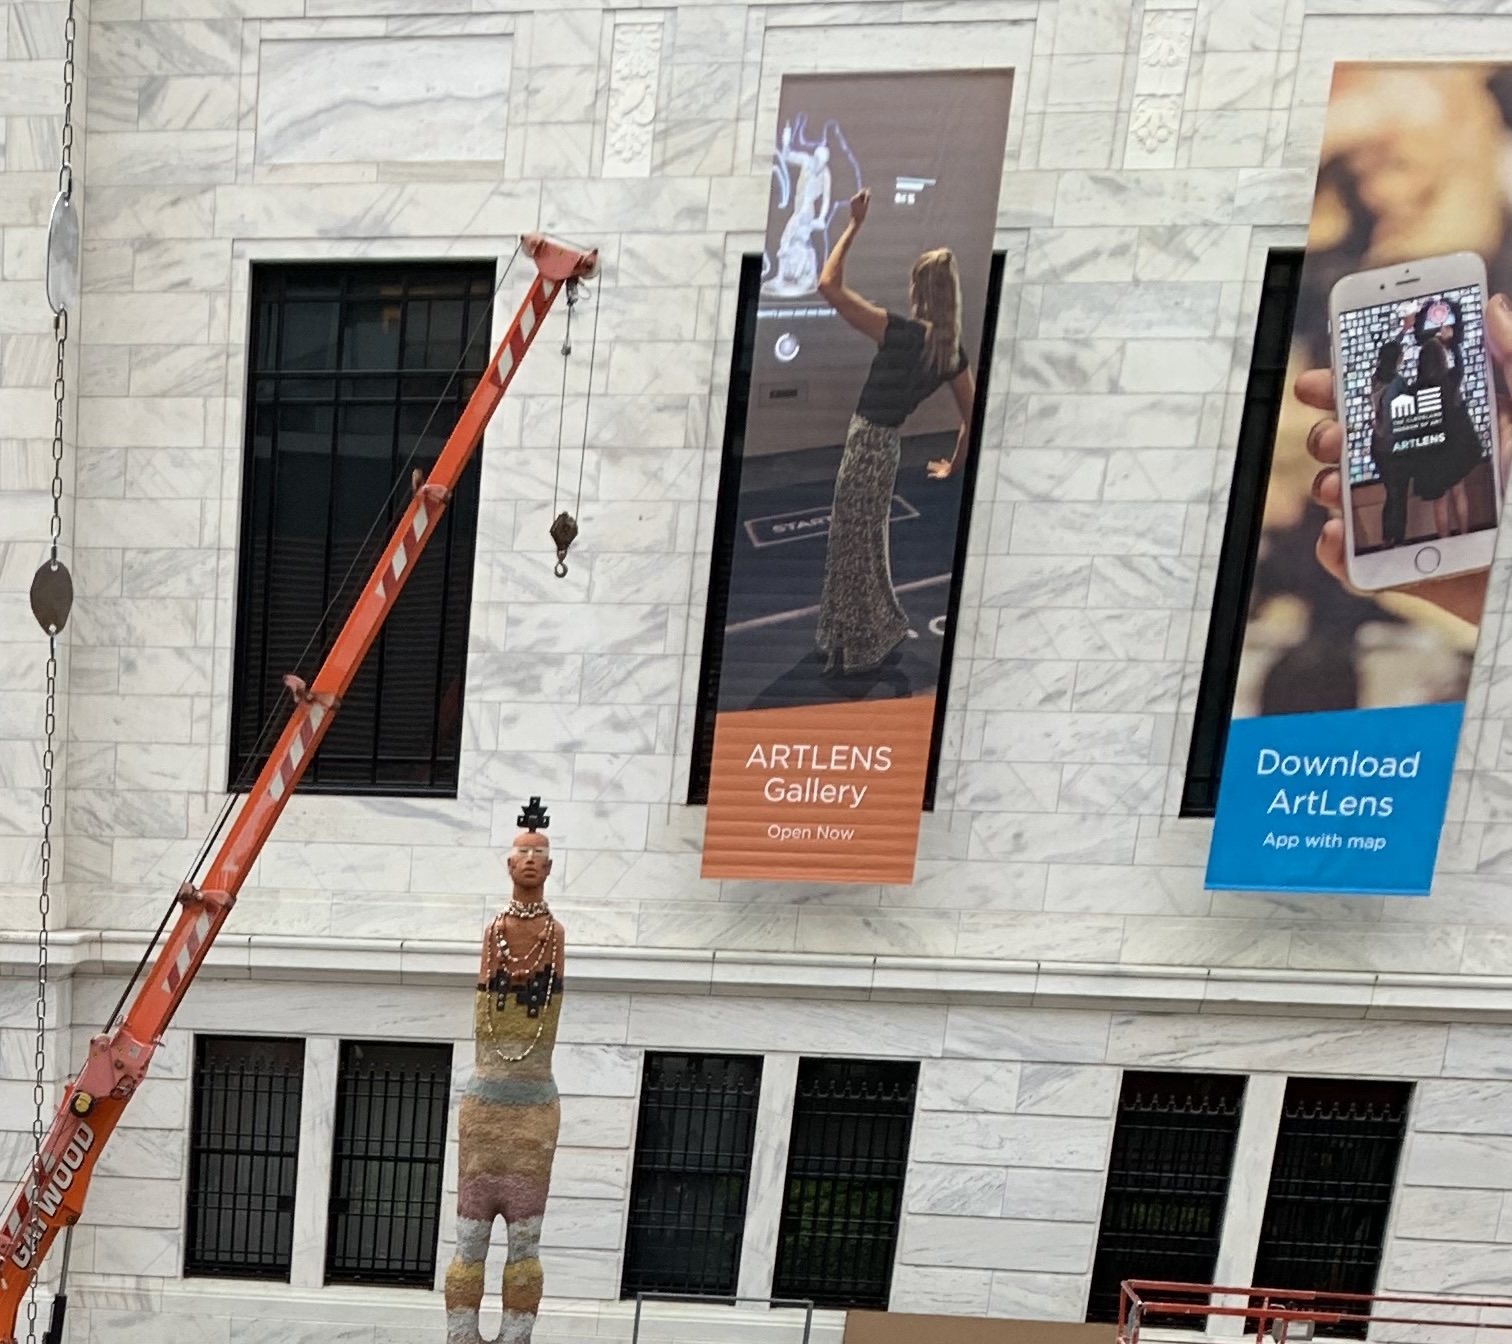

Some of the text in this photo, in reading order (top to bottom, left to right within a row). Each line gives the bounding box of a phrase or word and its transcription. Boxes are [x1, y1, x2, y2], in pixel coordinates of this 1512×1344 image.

[1392, 432, 1446, 453] ARTLENS
[745, 743, 892, 771] ARTLENS
[1256, 748, 1421, 778] Download
[764, 777, 868, 808] Gallery
[1267, 788, 1394, 817] ArtLens
[767, 824, 854, 841] Open Now
[1262, 832, 1387, 851] App with map
[11, 1121, 96, 1270] GATWOOD
